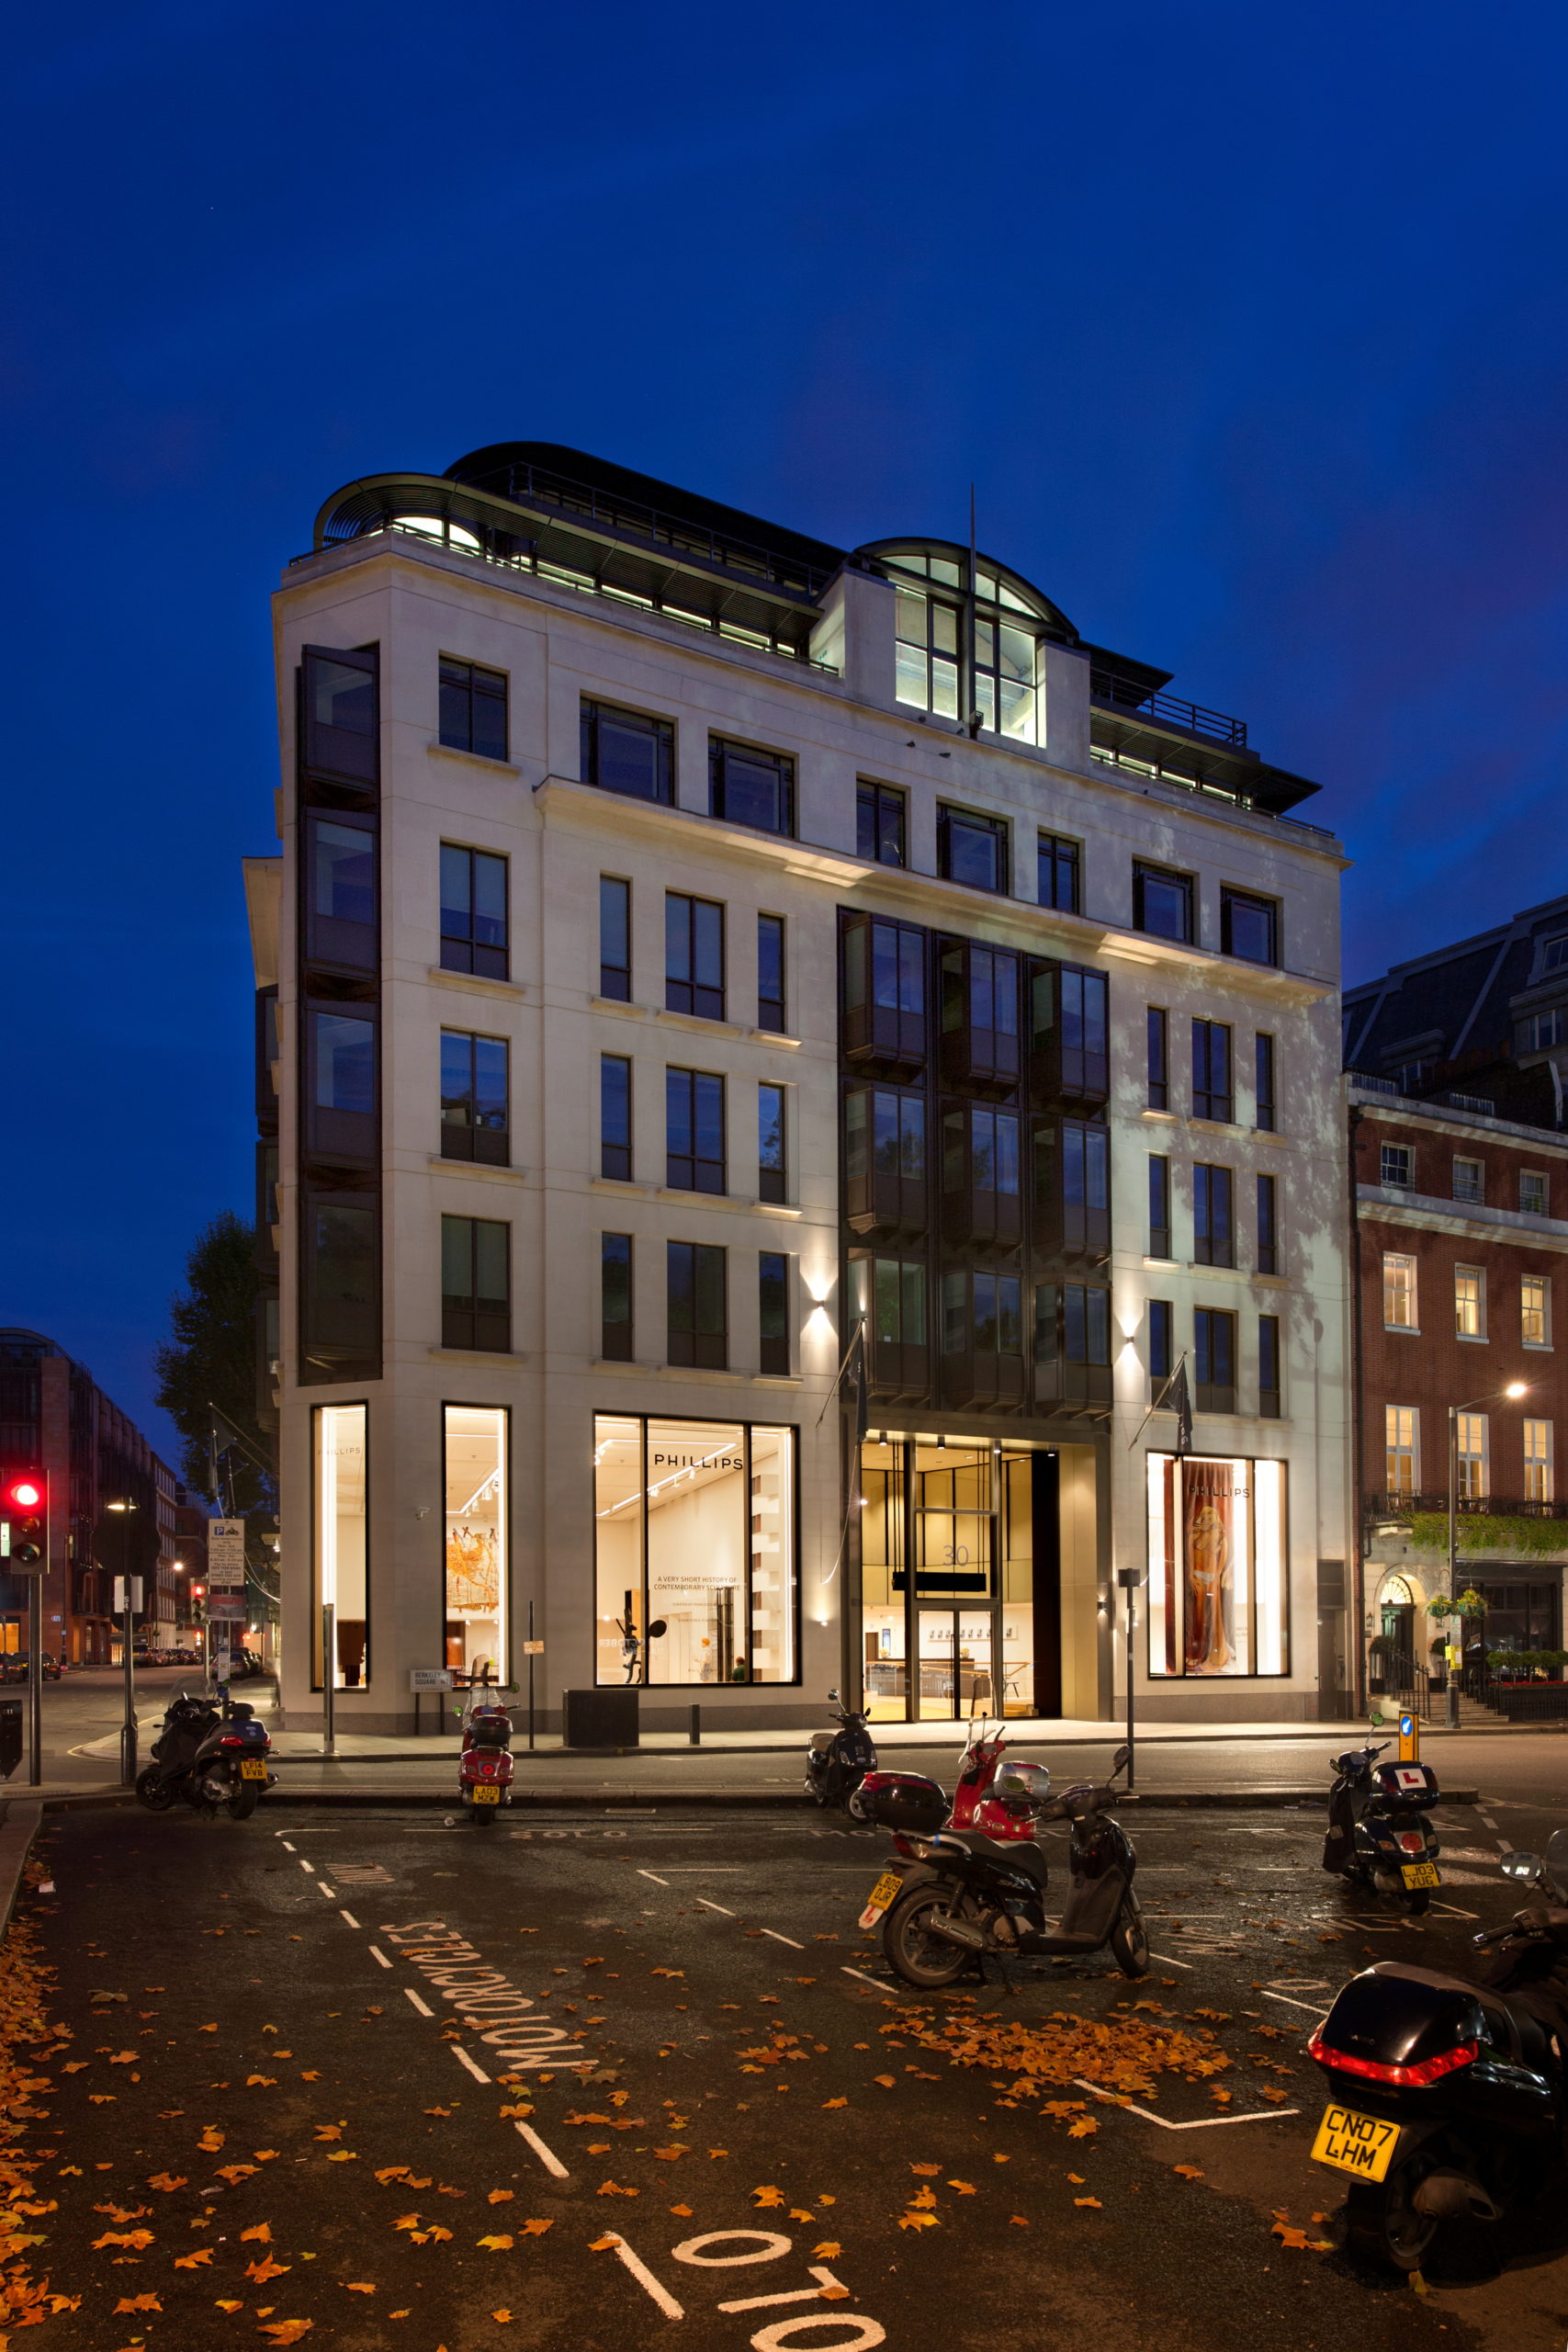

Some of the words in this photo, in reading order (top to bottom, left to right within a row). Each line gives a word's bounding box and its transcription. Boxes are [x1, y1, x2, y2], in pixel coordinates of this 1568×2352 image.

[654, 1453, 743, 1470] PHILLIPS
[1189, 1485, 1250, 1498] PHILLIPS
[942, 1544, 969, 1566] 30
[1402, 1771, 1420, 1784] L
[475, 1787, 499, 1795] LA03
[509, 1830, 627, 1839] SOLO
[1403, 1865, 1435, 1878] LJ03
[1409, 1875, 1434, 1887] YUG
[378, 1920, 601, 2072] MOTORCYCLES
[1326, 2109, 1394, 2147] CN07
[1325, 2134, 1378, 2171] LHM
